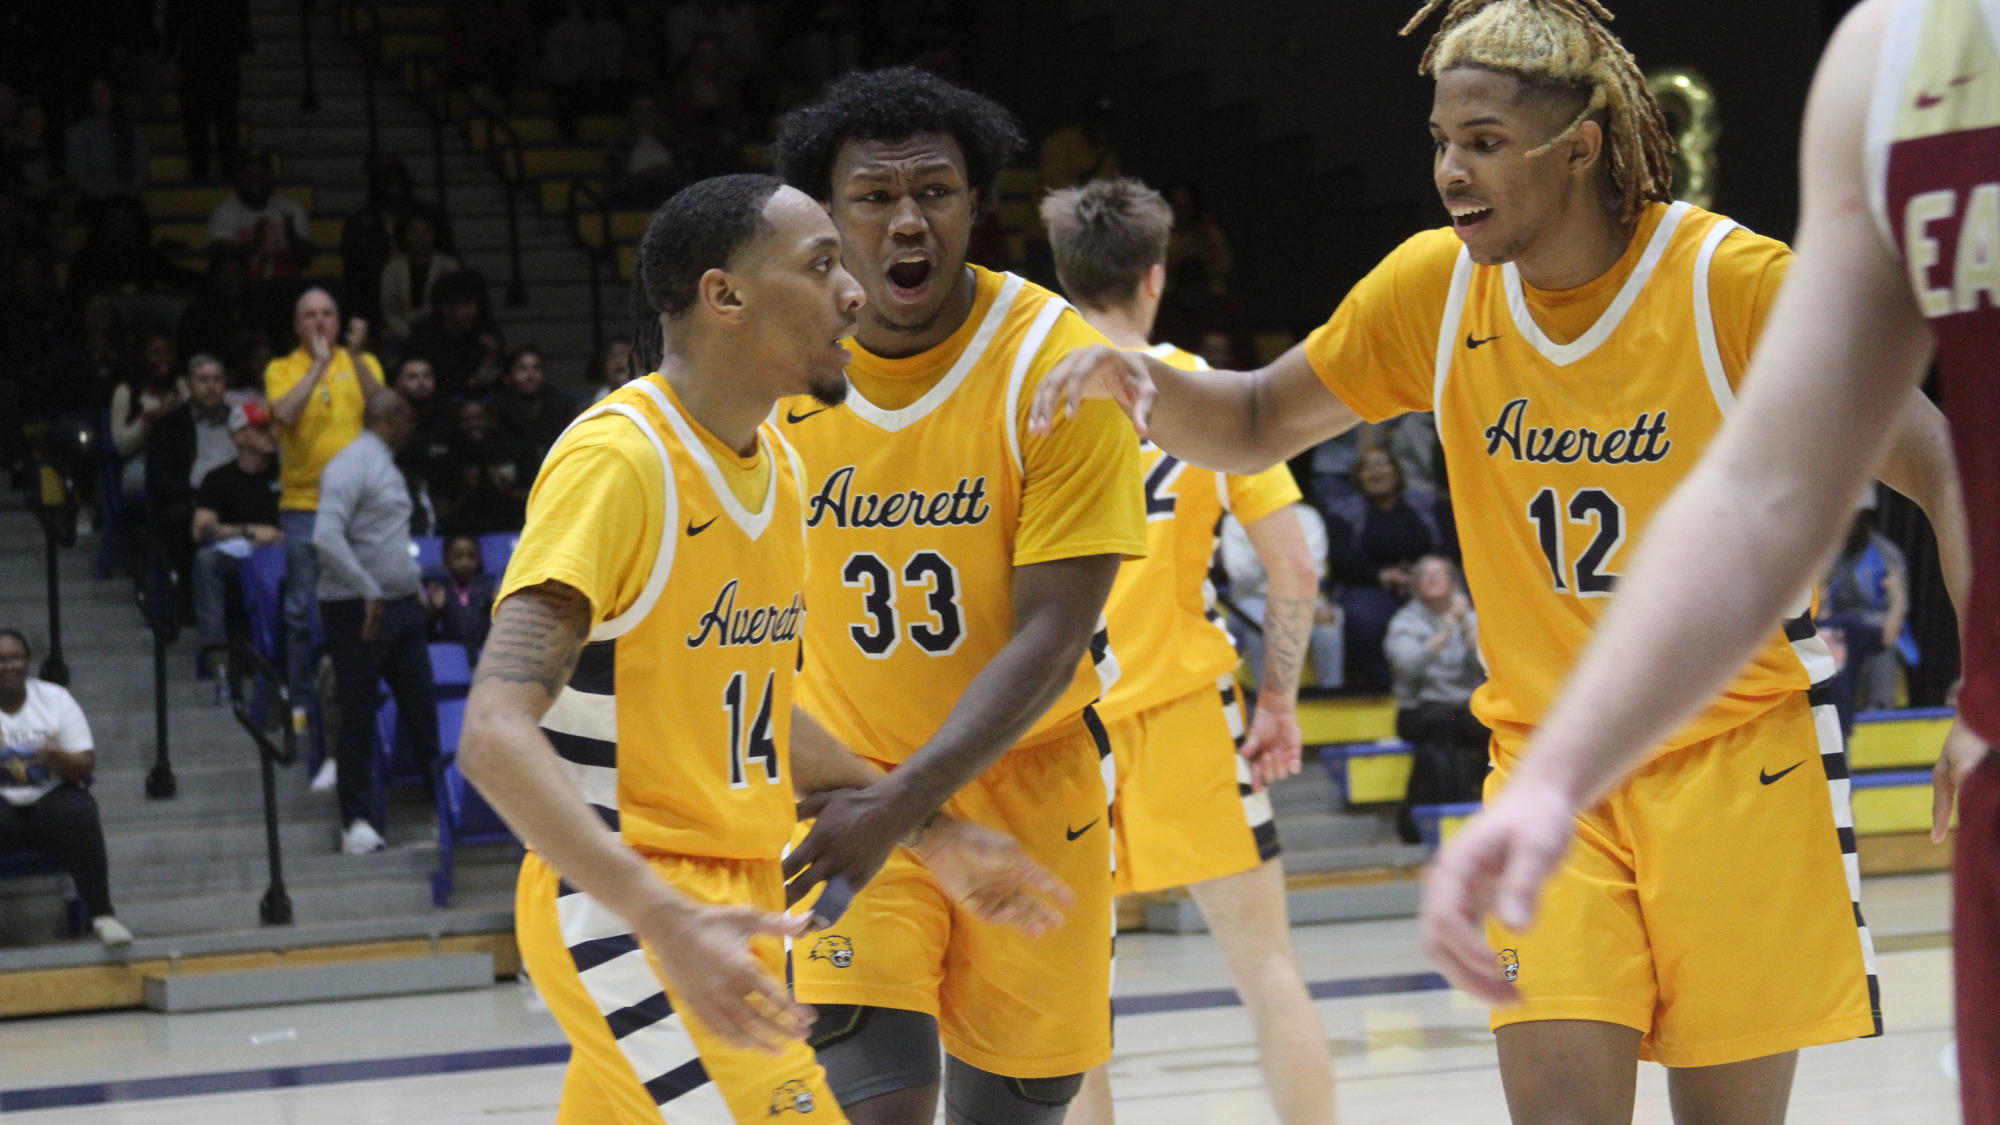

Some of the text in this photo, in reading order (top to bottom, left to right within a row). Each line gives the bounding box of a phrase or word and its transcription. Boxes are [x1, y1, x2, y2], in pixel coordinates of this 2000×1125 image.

[1484, 397, 1672, 465] Averett
[807, 466, 991, 529] Averett
[1526, 485, 1627, 598] 12
[841, 549, 967, 660] 33
[722, 668, 781, 790] 14
